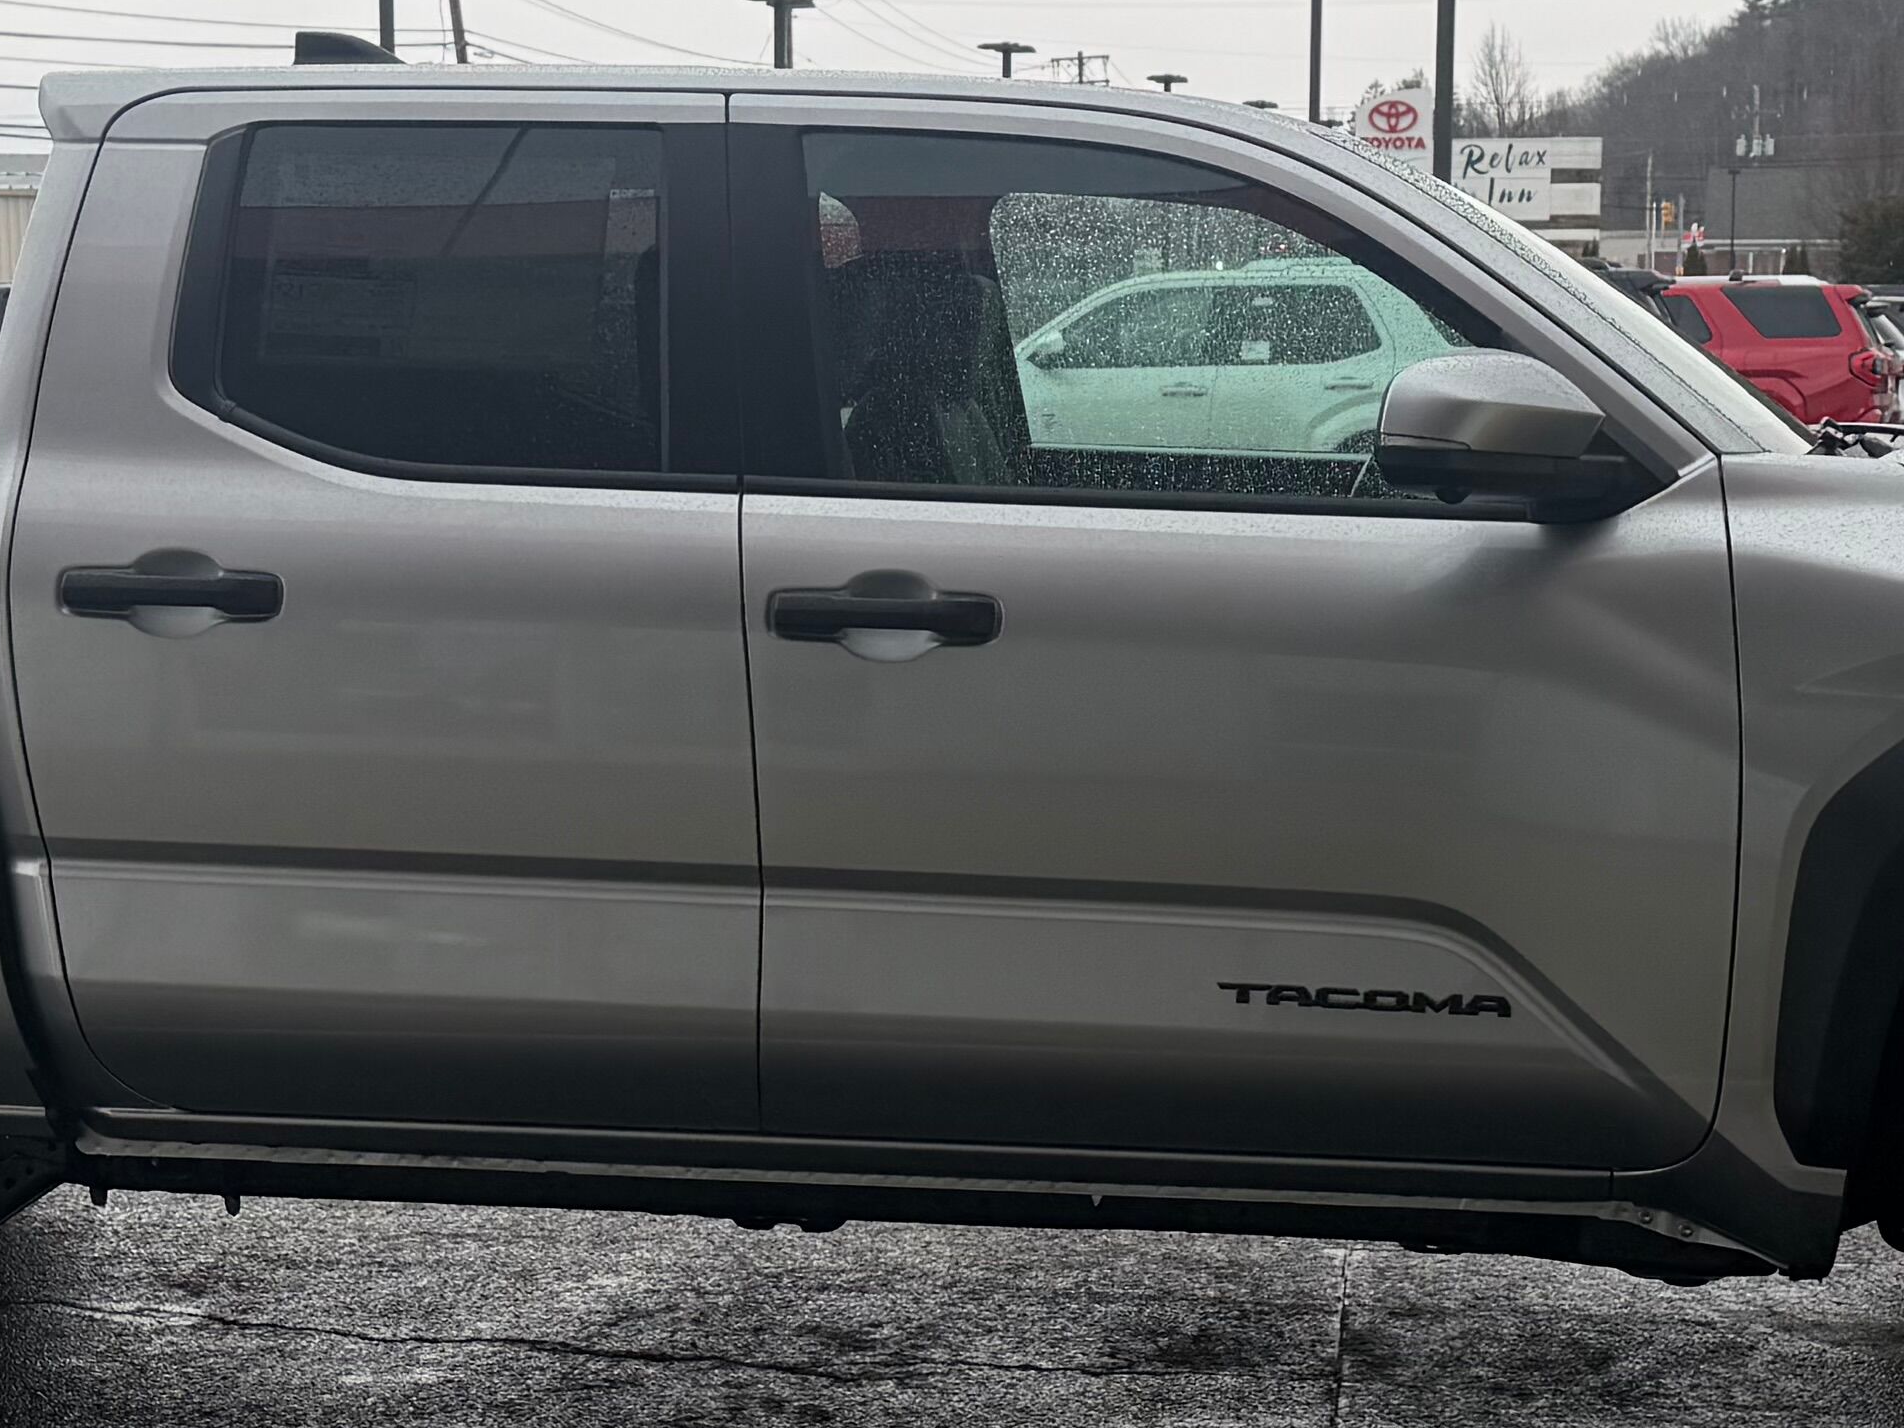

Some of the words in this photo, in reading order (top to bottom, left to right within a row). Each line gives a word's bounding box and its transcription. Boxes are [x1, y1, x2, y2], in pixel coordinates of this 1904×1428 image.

[1460, 143, 1547, 180] Relax
[1488, 177, 1537, 206] Inn
[1217, 982, 1512, 1018] TACOMA
